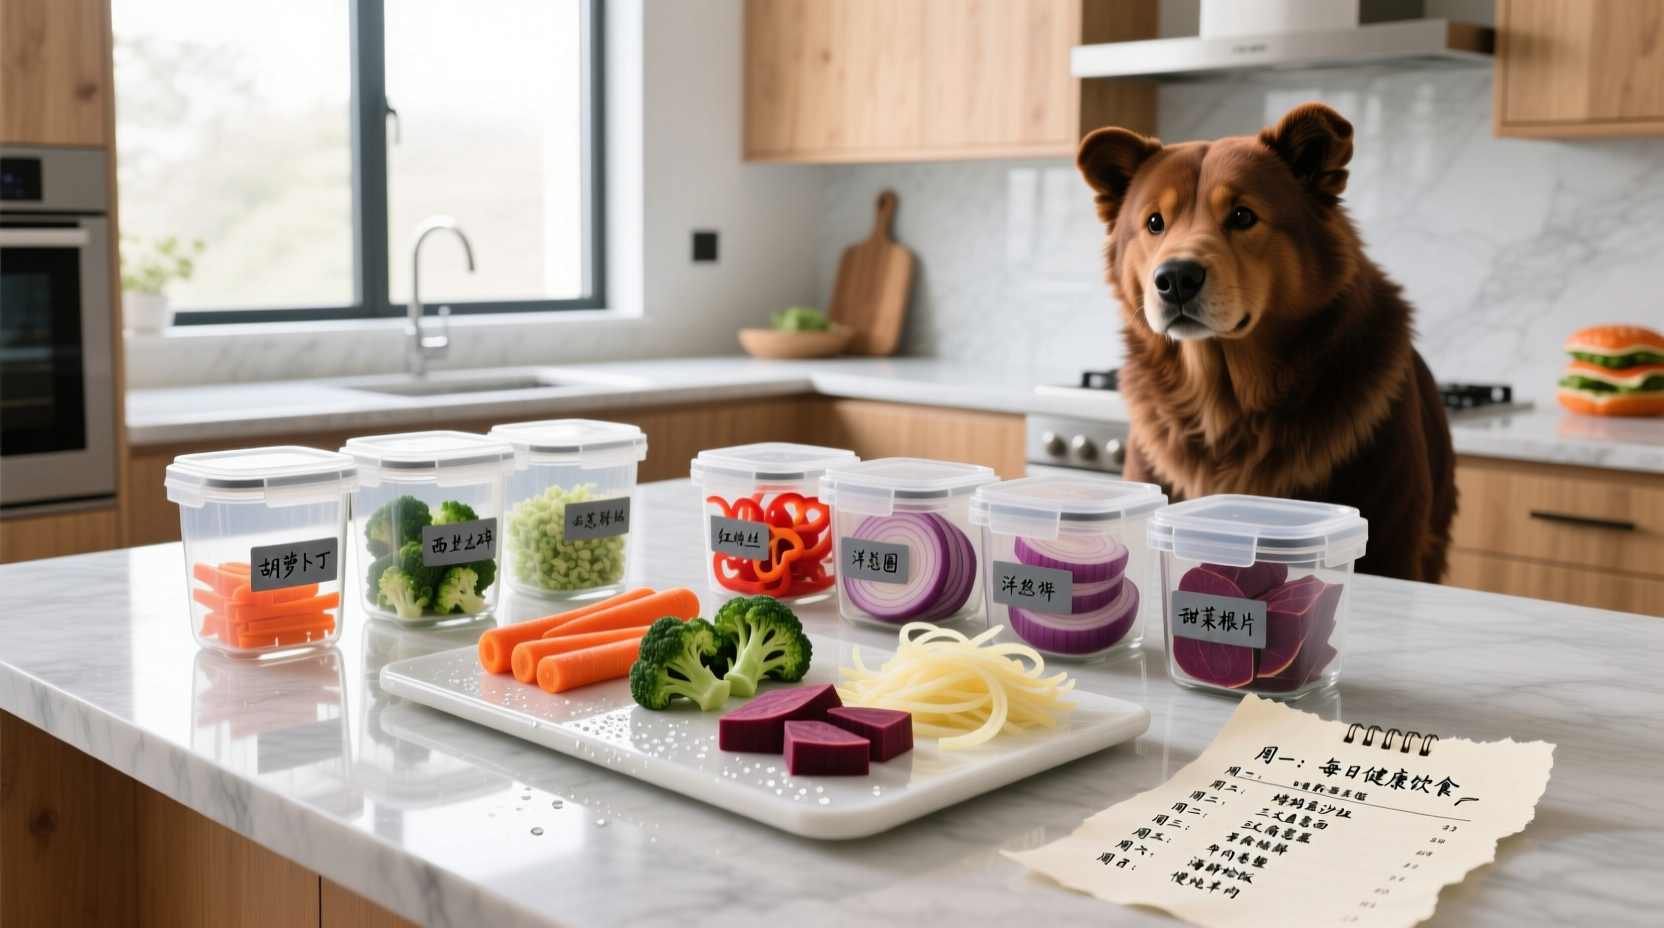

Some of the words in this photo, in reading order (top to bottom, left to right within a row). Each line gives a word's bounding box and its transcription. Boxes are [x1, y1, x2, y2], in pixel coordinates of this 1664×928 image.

[258, 550, 332, 580] 胡萝卜丁
[1178, 605, 1255, 637] 甜菜根片
